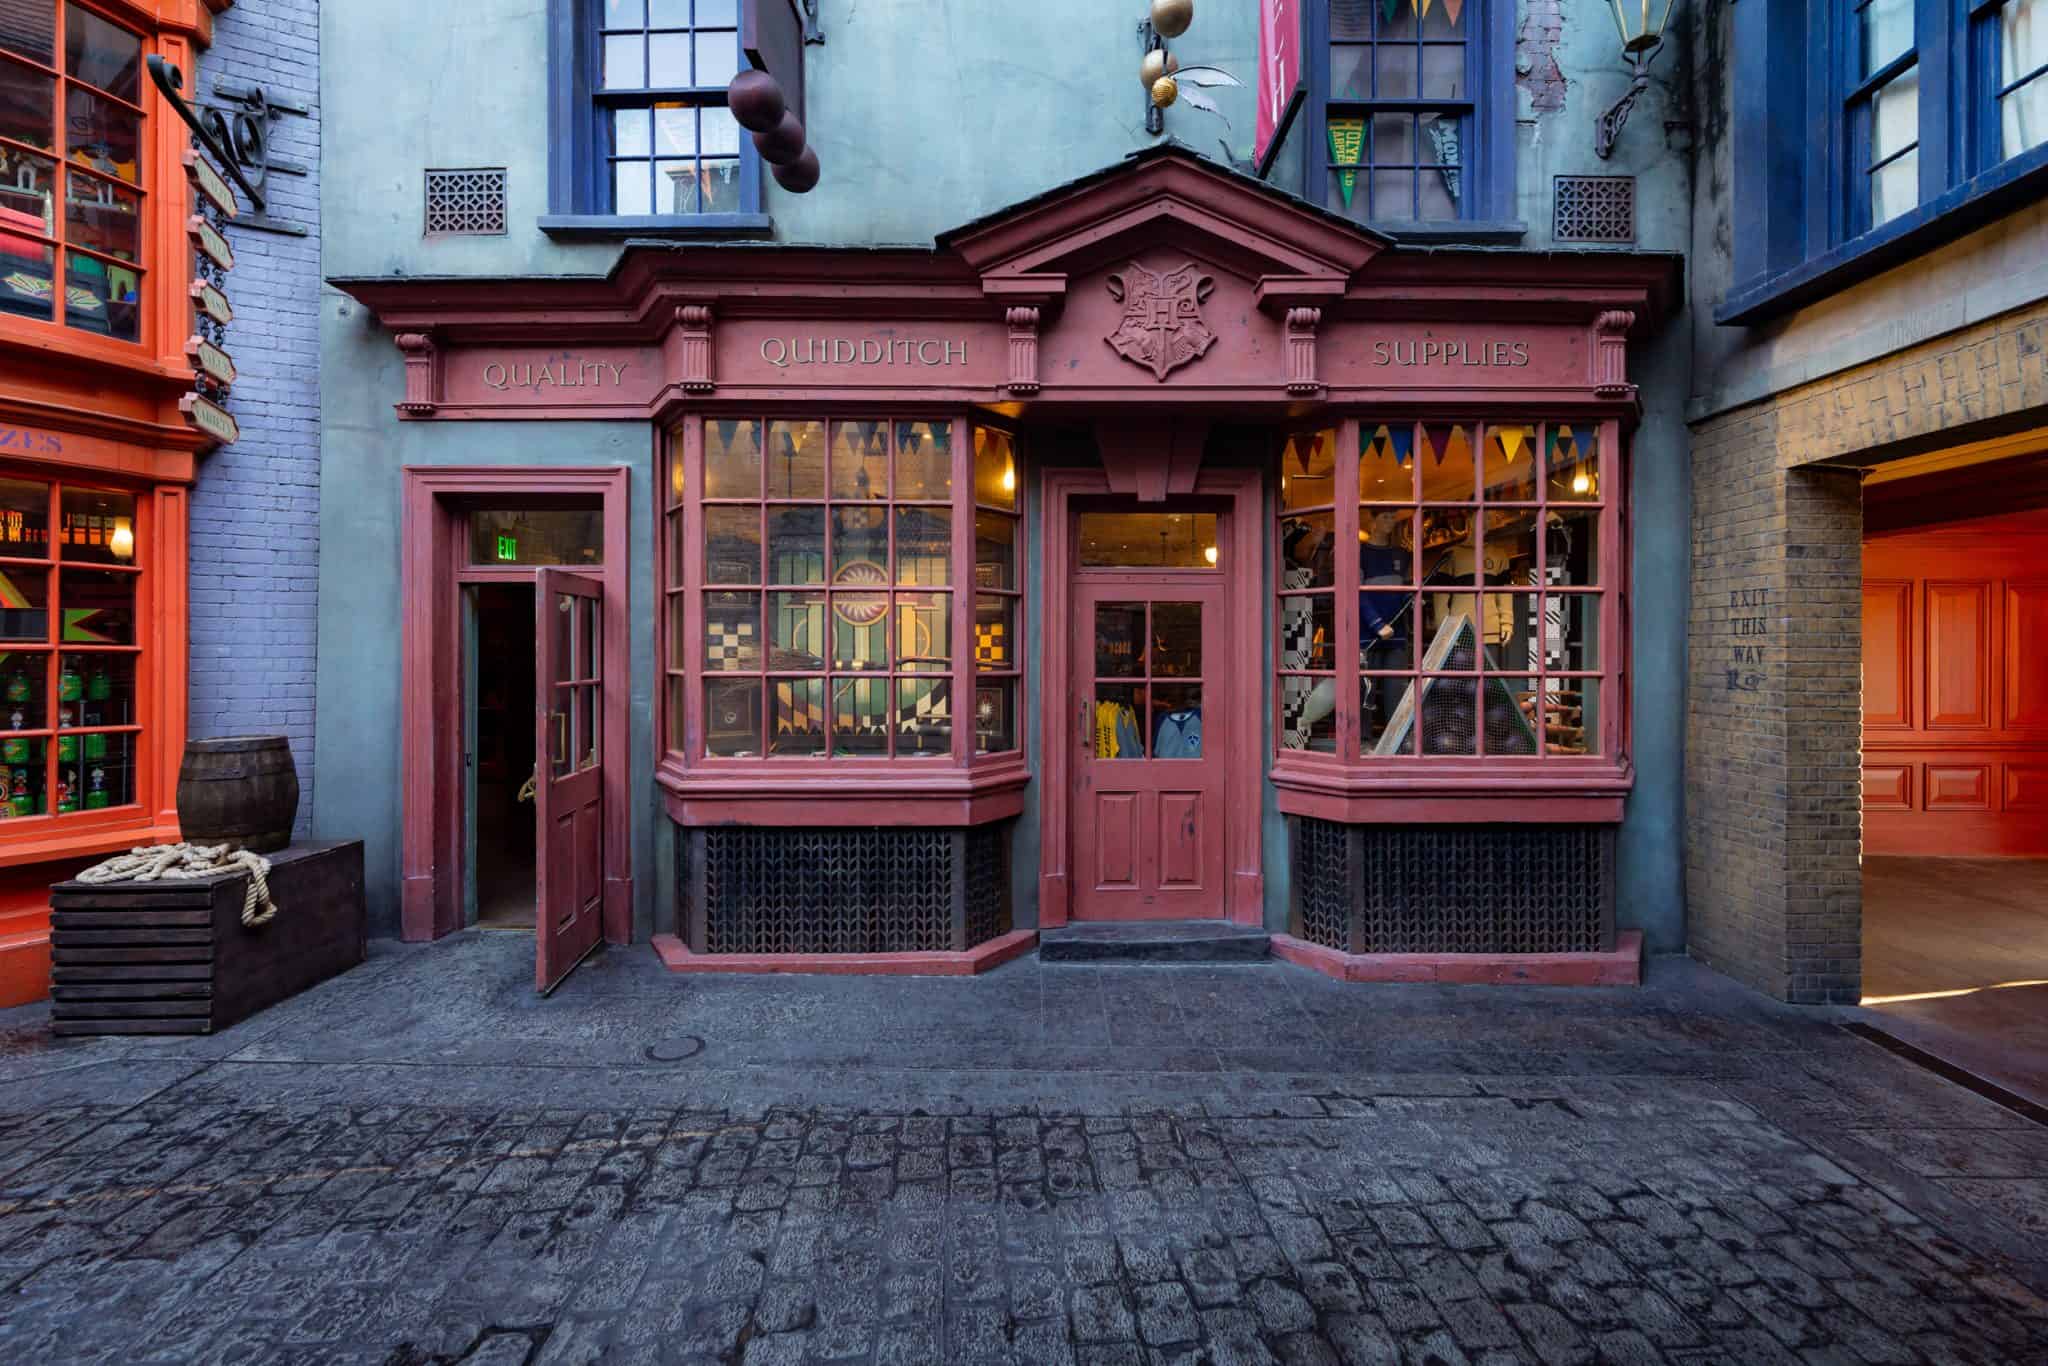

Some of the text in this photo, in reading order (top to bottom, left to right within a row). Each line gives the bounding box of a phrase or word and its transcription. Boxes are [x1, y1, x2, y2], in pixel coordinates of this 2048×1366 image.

[483, 336, 1529, 390] QUALITY QUIDDITCH SUPPLIES
[497, 535, 518, 561] EXIT
[1730, 588, 1769, 608] EXIT
[1730, 617, 1768, 635] THIS
[1733, 645, 1765, 665] WAY
